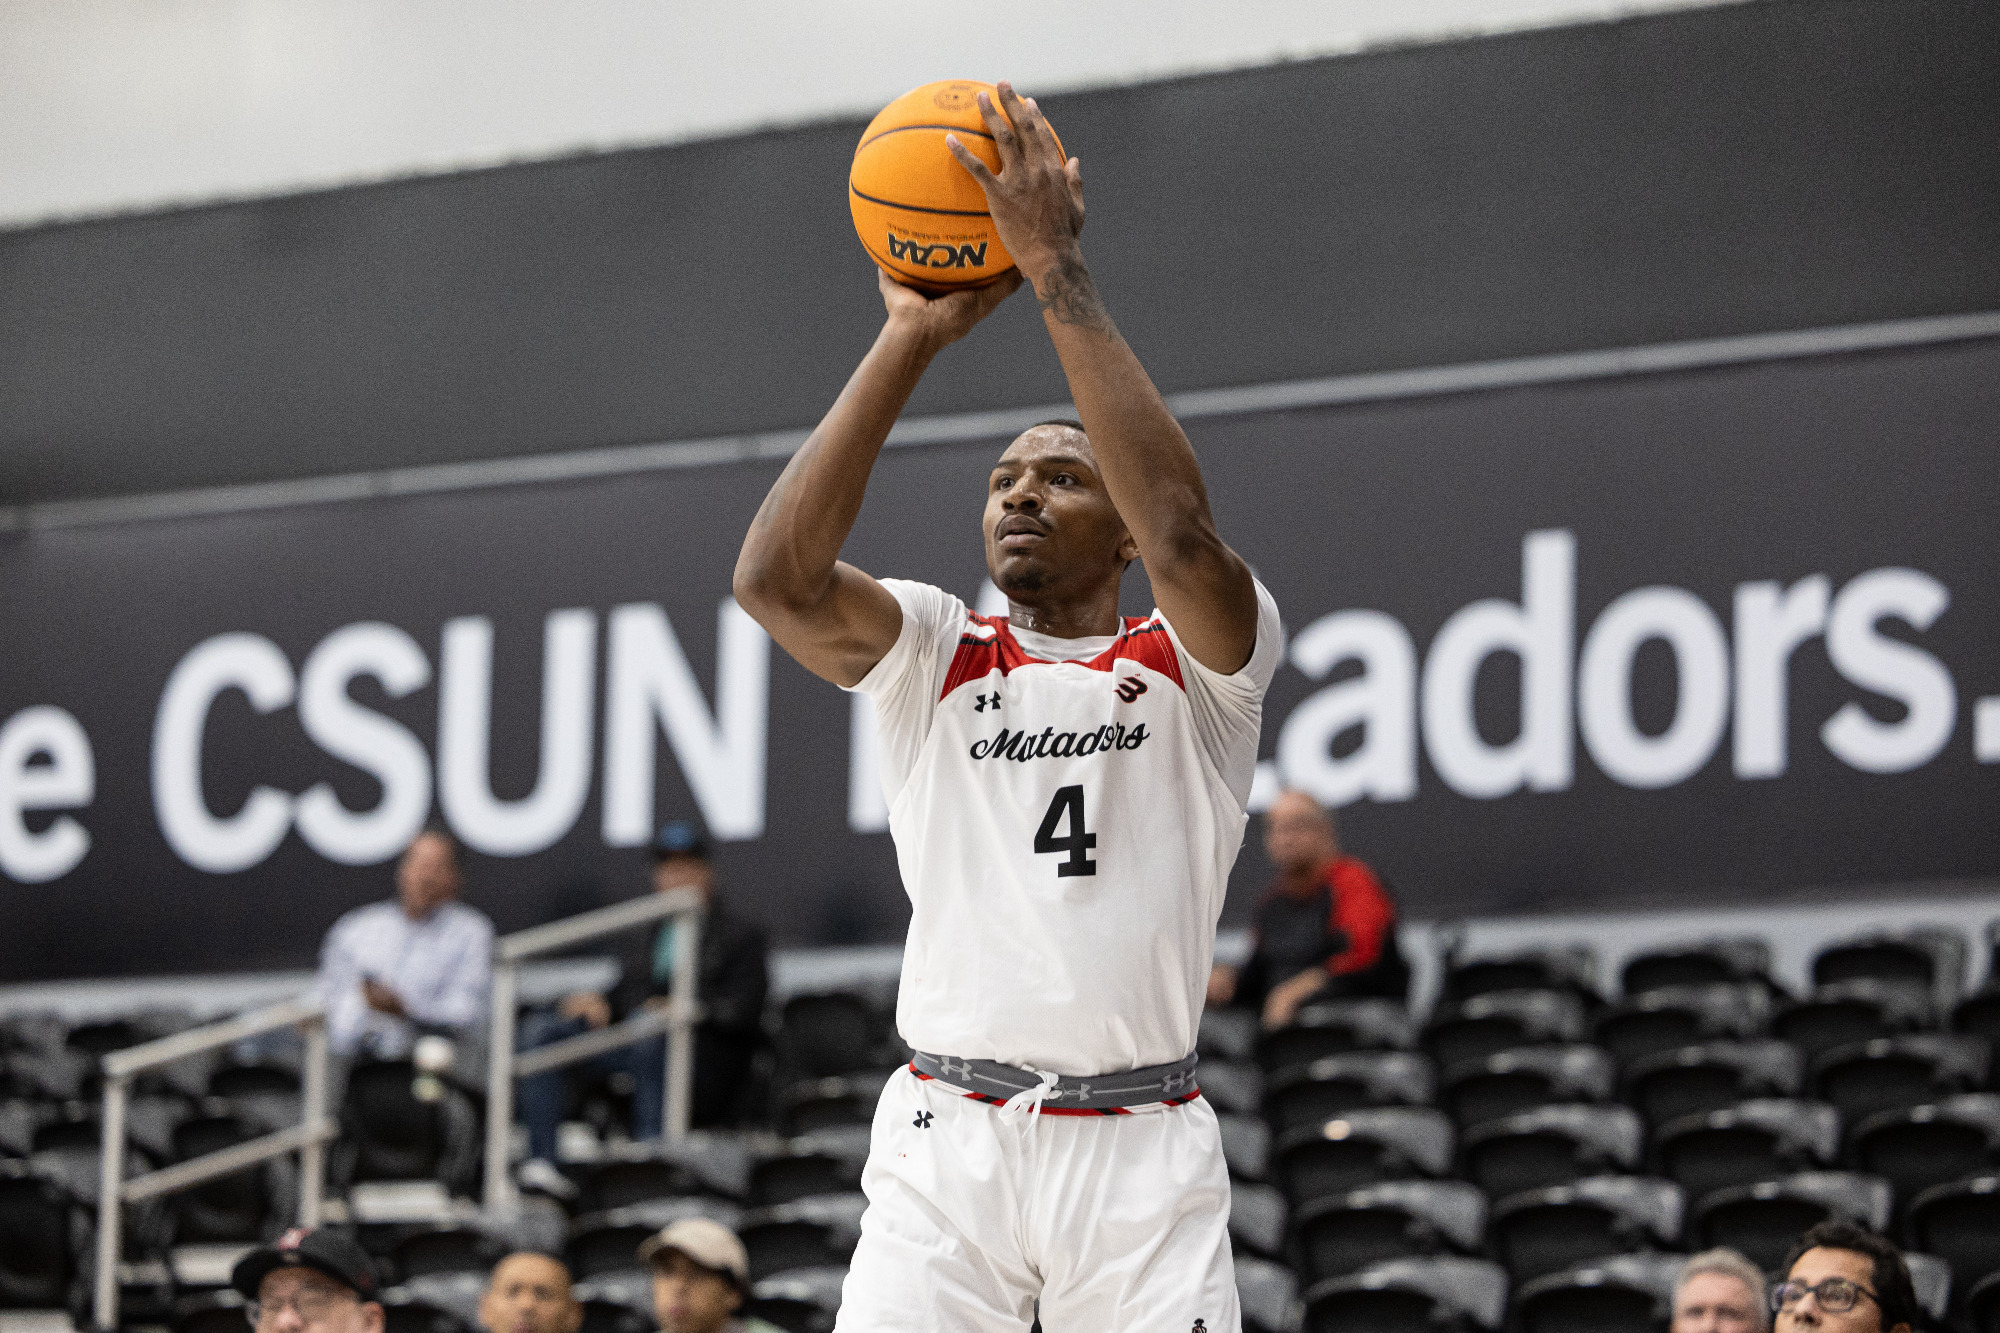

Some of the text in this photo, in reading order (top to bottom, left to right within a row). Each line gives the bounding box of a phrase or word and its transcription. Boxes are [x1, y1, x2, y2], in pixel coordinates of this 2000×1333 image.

[887, 231, 988, 269] NCAA
[151, 596, 771, 874] CSUN
[970, 721, 1150, 763] Matadors
[1033, 784, 1096, 878] 4
